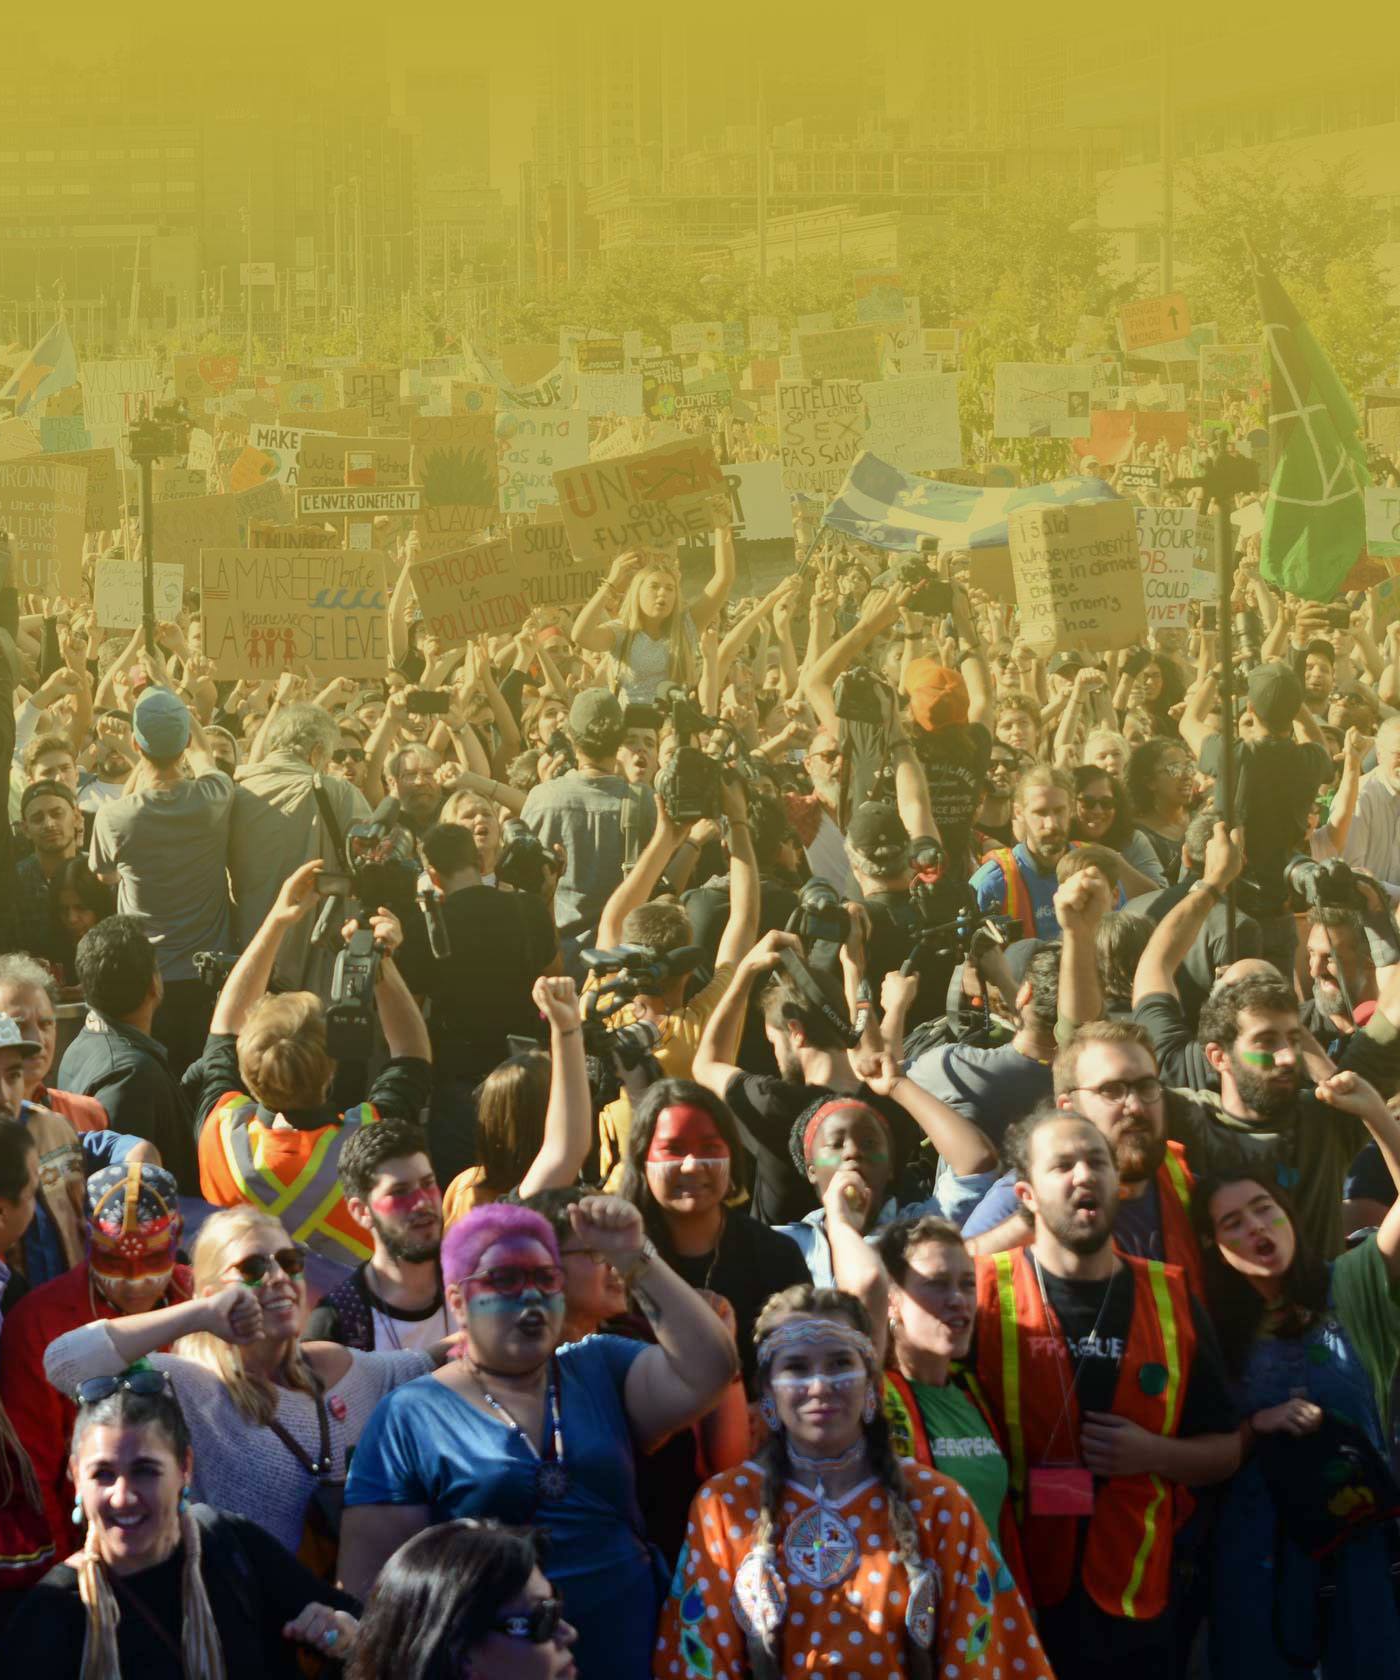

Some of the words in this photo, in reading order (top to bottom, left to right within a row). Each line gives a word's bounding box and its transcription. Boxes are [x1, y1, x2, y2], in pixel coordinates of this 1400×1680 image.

[779, 384, 864, 410] PIPELINES
[256, 428, 299, 449] MAKE
[782, 415, 862, 446] SEX
[781, 445, 816, 467] PAS
[1123, 475, 1158, 488] COOL
[303, 490, 420, 512] L'ENVIRONEMENT
[627, 500, 672, 521] OUR
[1153, 507, 1184, 526] YOU
[591, 506, 712, 550] FUTURE
[1149, 527, 1194, 549] YOUR
[418, 542, 510, 593] PHOQUE
[548, 549, 574, 569] PAS
[1069, 561, 1088, 578] in
[1089, 554, 1139, 578] climate
[201, 556, 232, 589] LA
[320, 556, 377, 589] Monte
[459, 586, 481, 603] LA
[1145, 578, 1190, 599] COULD
[429, 591, 532, 640] POLLUTION
[1062, 617, 1099, 633] hoe
[203, 615, 241, 661] LA
[241, 608, 301, 637] jeunesse
[293, 614, 328, 661] SE
